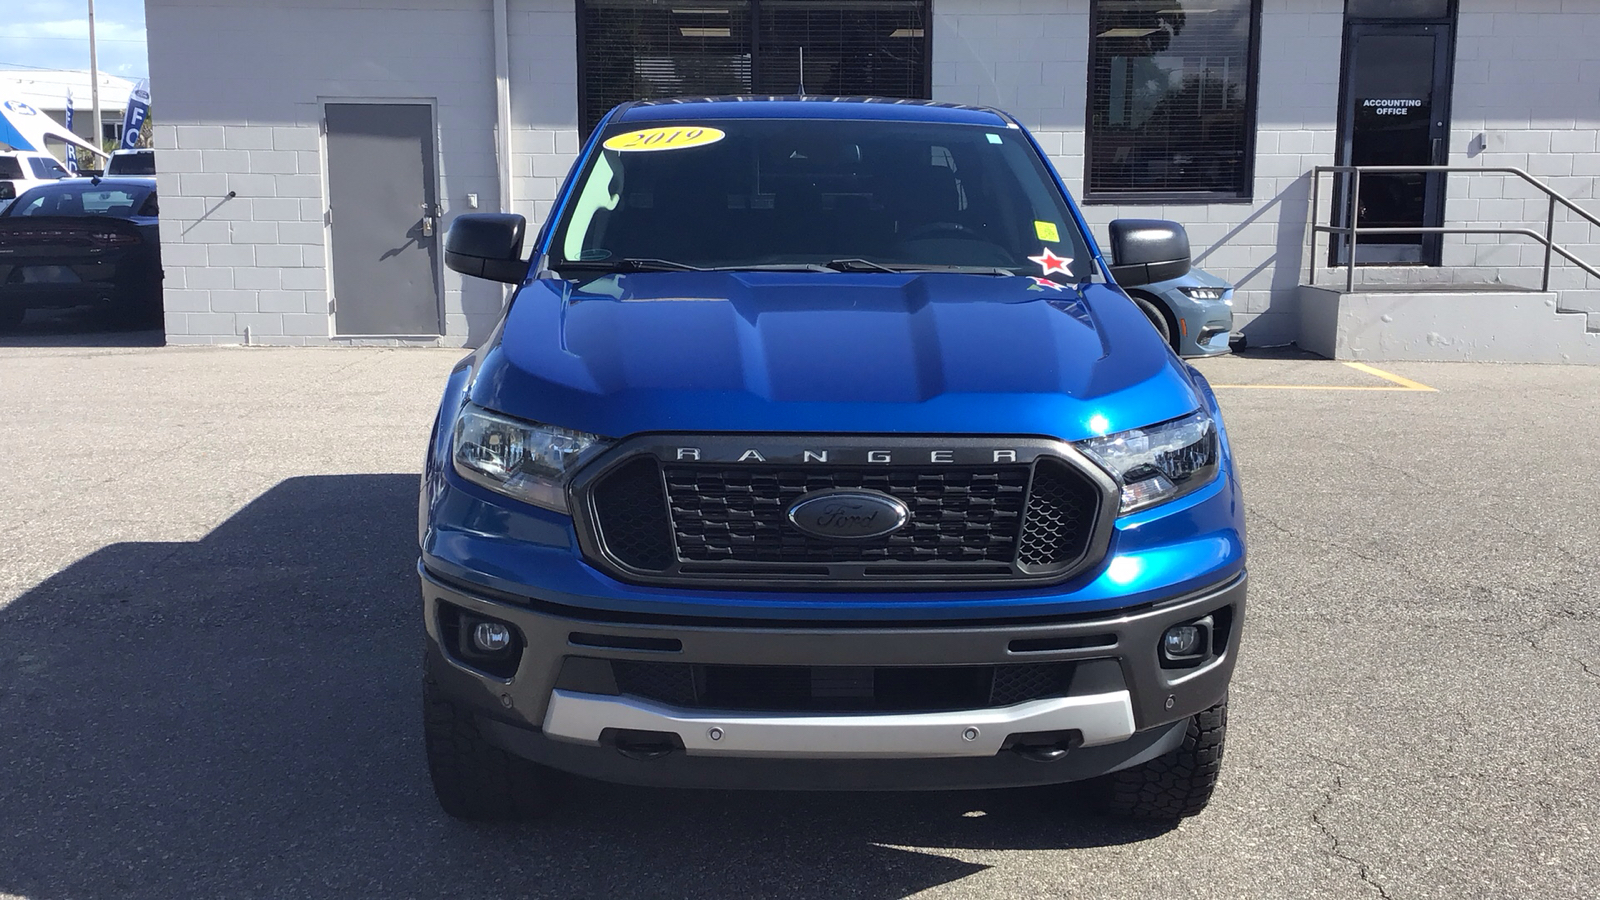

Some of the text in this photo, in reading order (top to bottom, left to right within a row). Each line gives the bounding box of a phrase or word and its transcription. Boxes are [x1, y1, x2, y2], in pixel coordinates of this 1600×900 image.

[1363, 99, 1421, 107] ACCOUNTING
[623, 129, 703, 147] 2019
[676, 447, 1017, 464] RANGER
[815, 502, 878, 529] Ford
